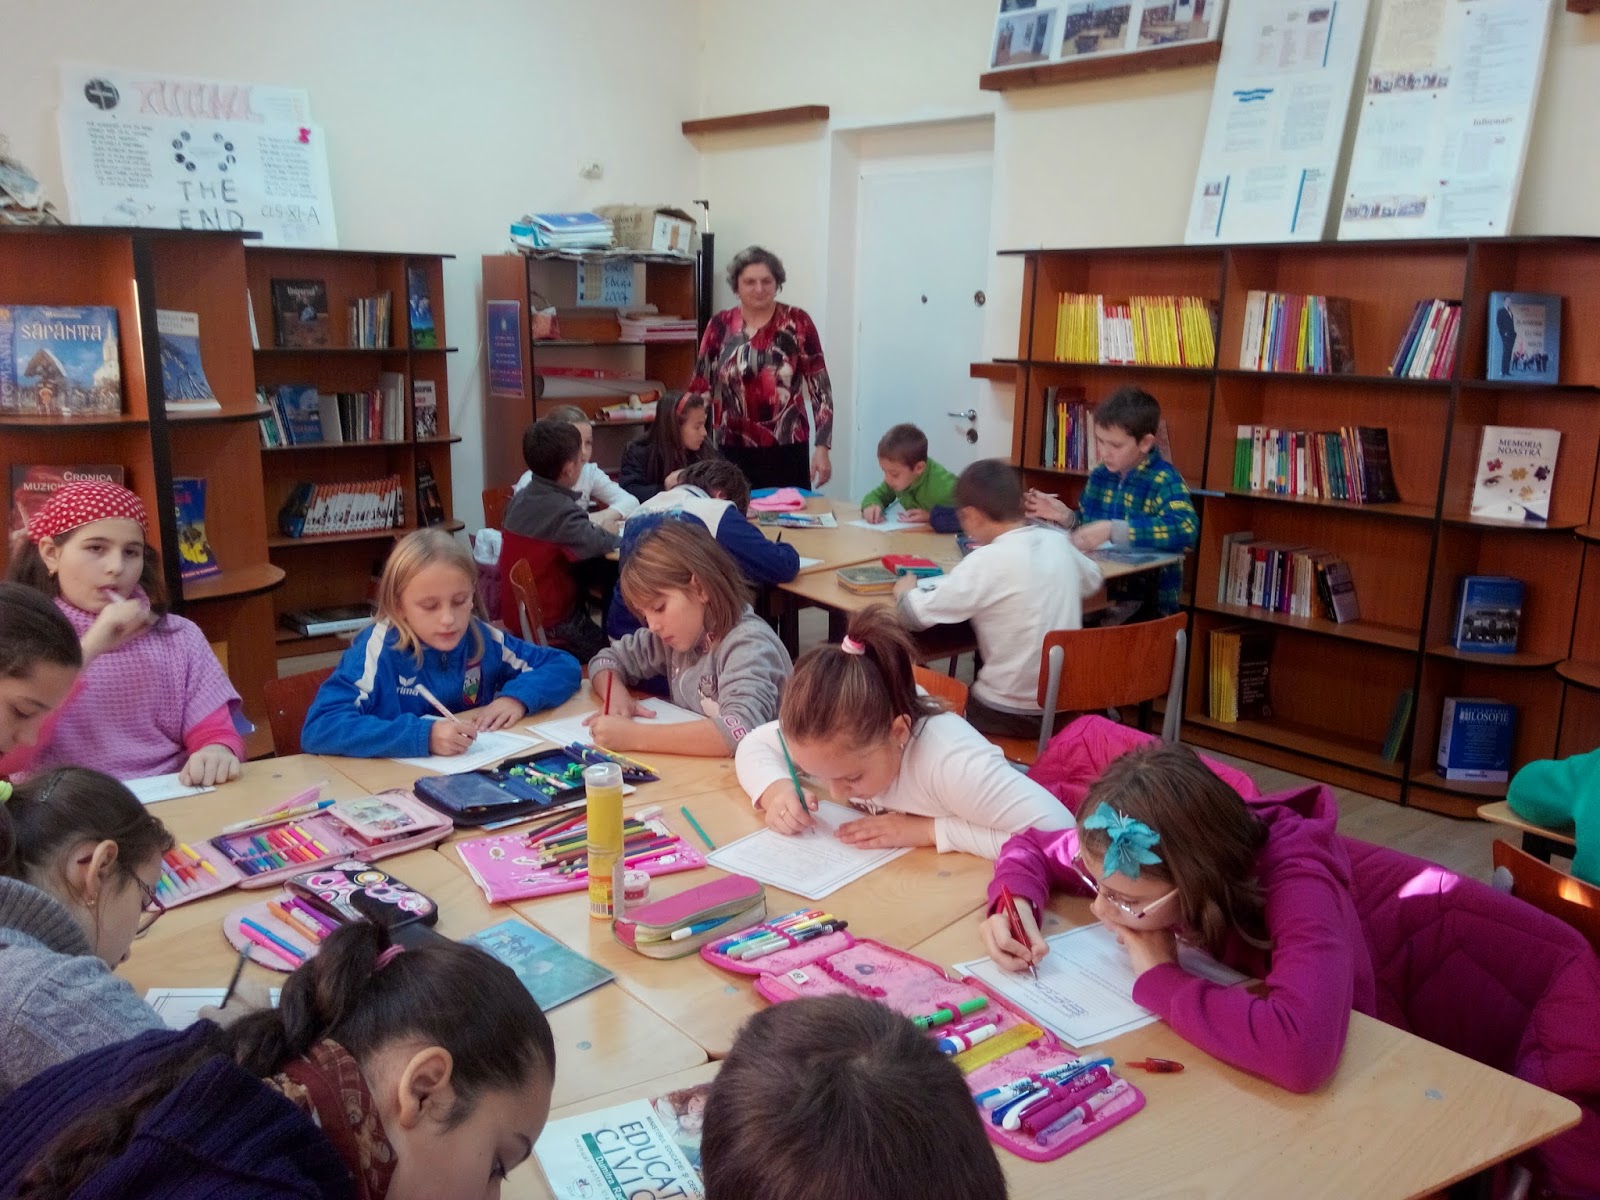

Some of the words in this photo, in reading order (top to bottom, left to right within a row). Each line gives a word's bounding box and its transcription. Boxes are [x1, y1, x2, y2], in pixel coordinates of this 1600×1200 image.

[177, 178, 238, 203] THE
[178, 206, 244, 231] END
[1498, 438, 1542, 449] MEMORIA
[63, 470, 113, 483] CRONICA
[646, 1115, 667, 1144] MINISTERUL
[574, 1138, 591, 1162] manual
[595, 1155, 615, 1185] Dumitra
